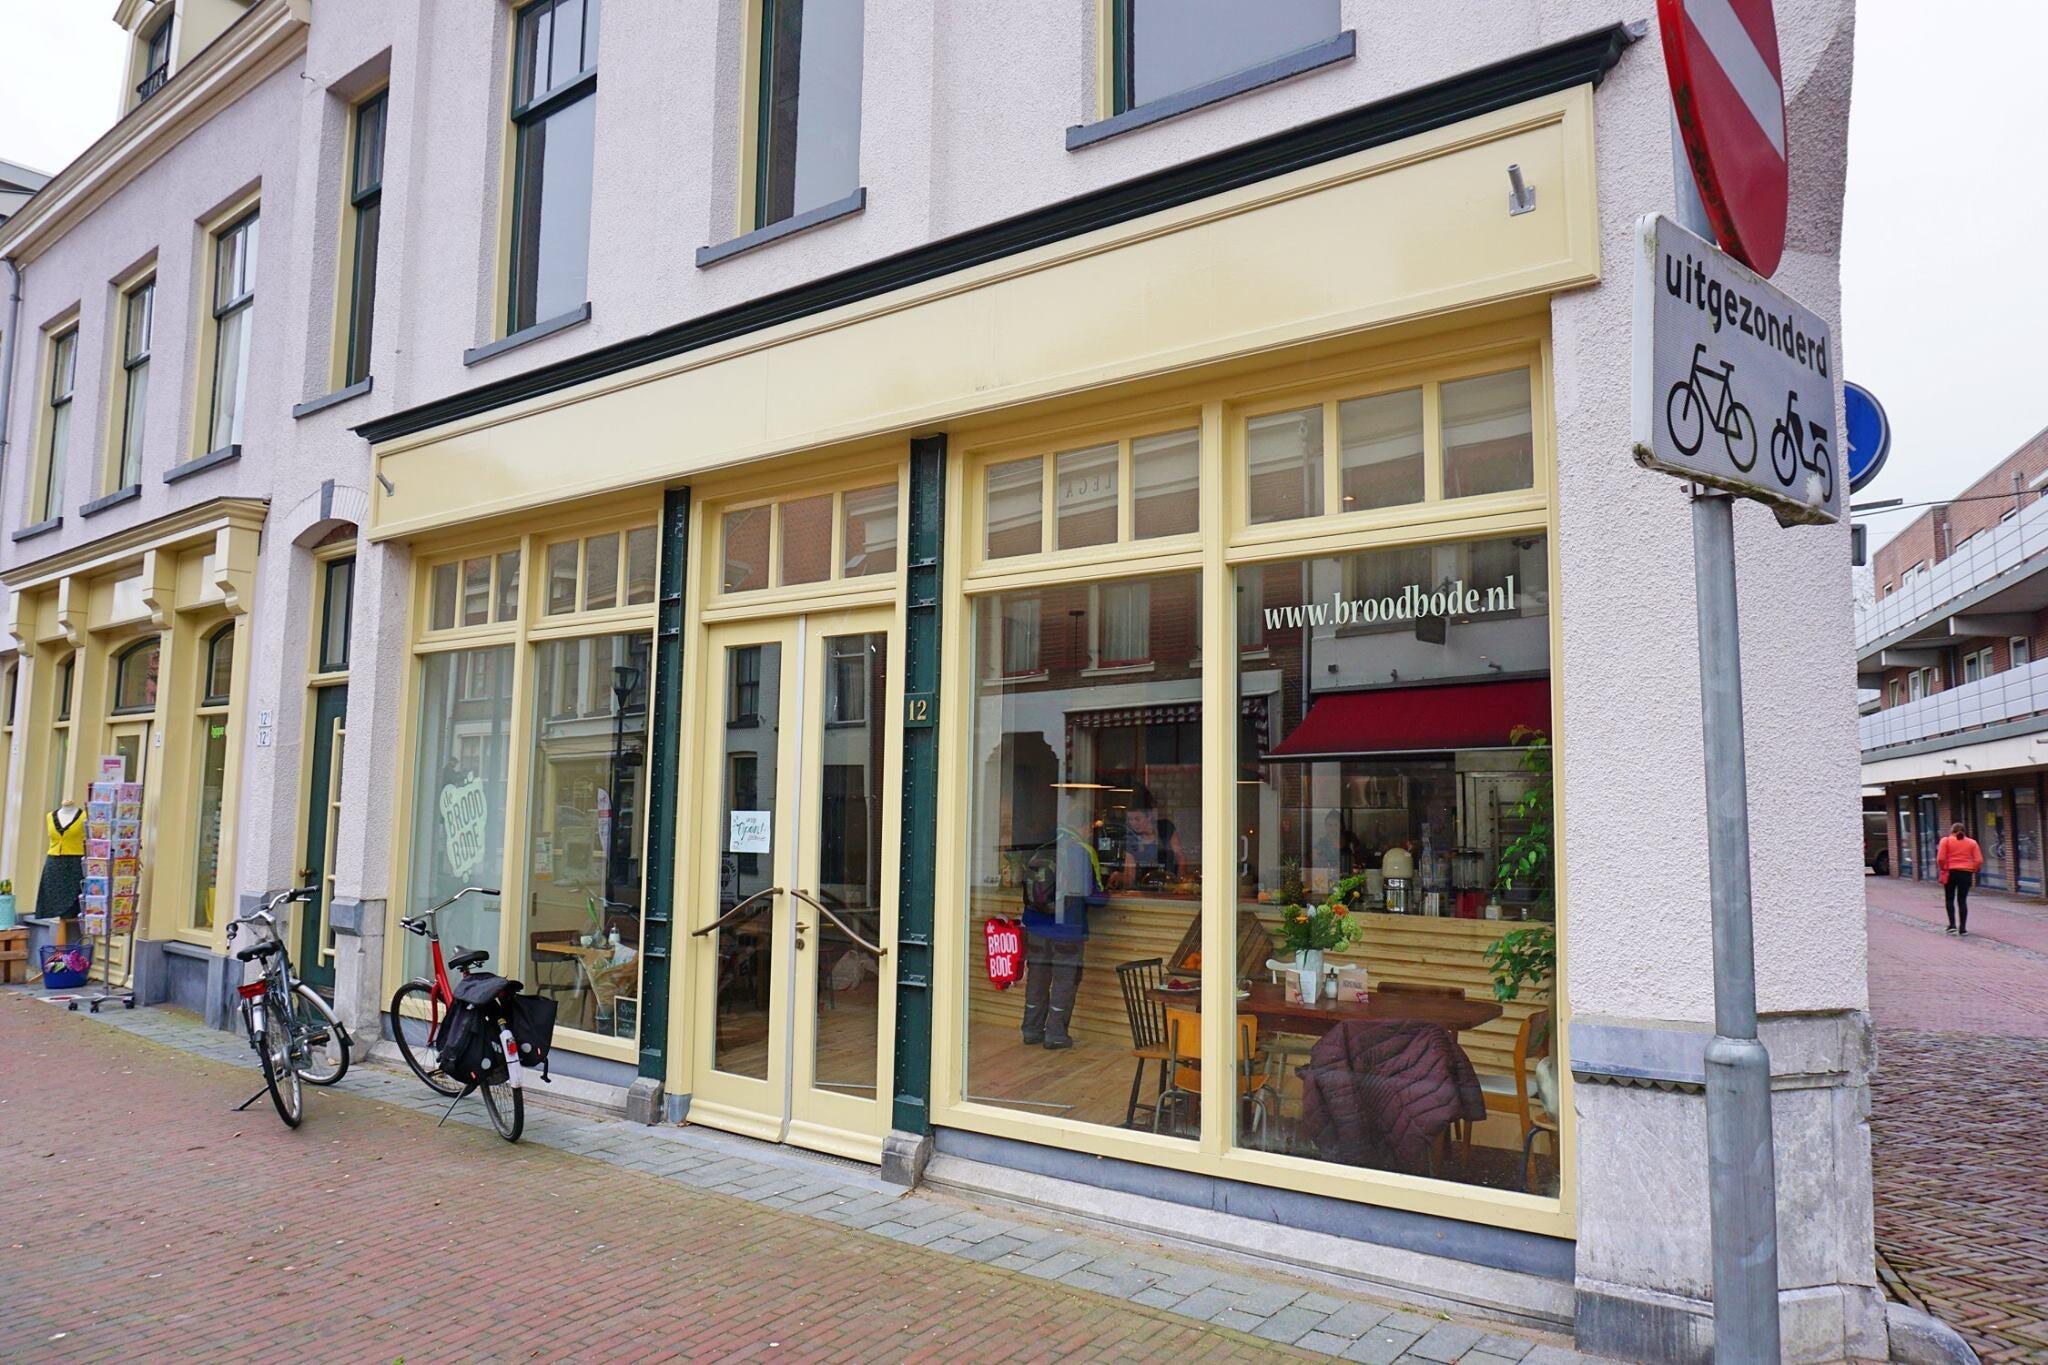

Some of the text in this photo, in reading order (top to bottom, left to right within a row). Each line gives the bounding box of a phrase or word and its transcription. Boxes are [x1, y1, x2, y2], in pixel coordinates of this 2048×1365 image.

[1666, 253, 1828, 378] uitgezonderd
[1263, 574, 1516, 631] www.broodbode.nl
[908, 699, 928, 721] 12
[443, 791, 453, 808] de
[446, 789, 484, 839] BROOD
[452, 822, 482, 870] BODE
[987, 932, 1018, 956] BROOD
[989, 955, 1014, 978] BODE
